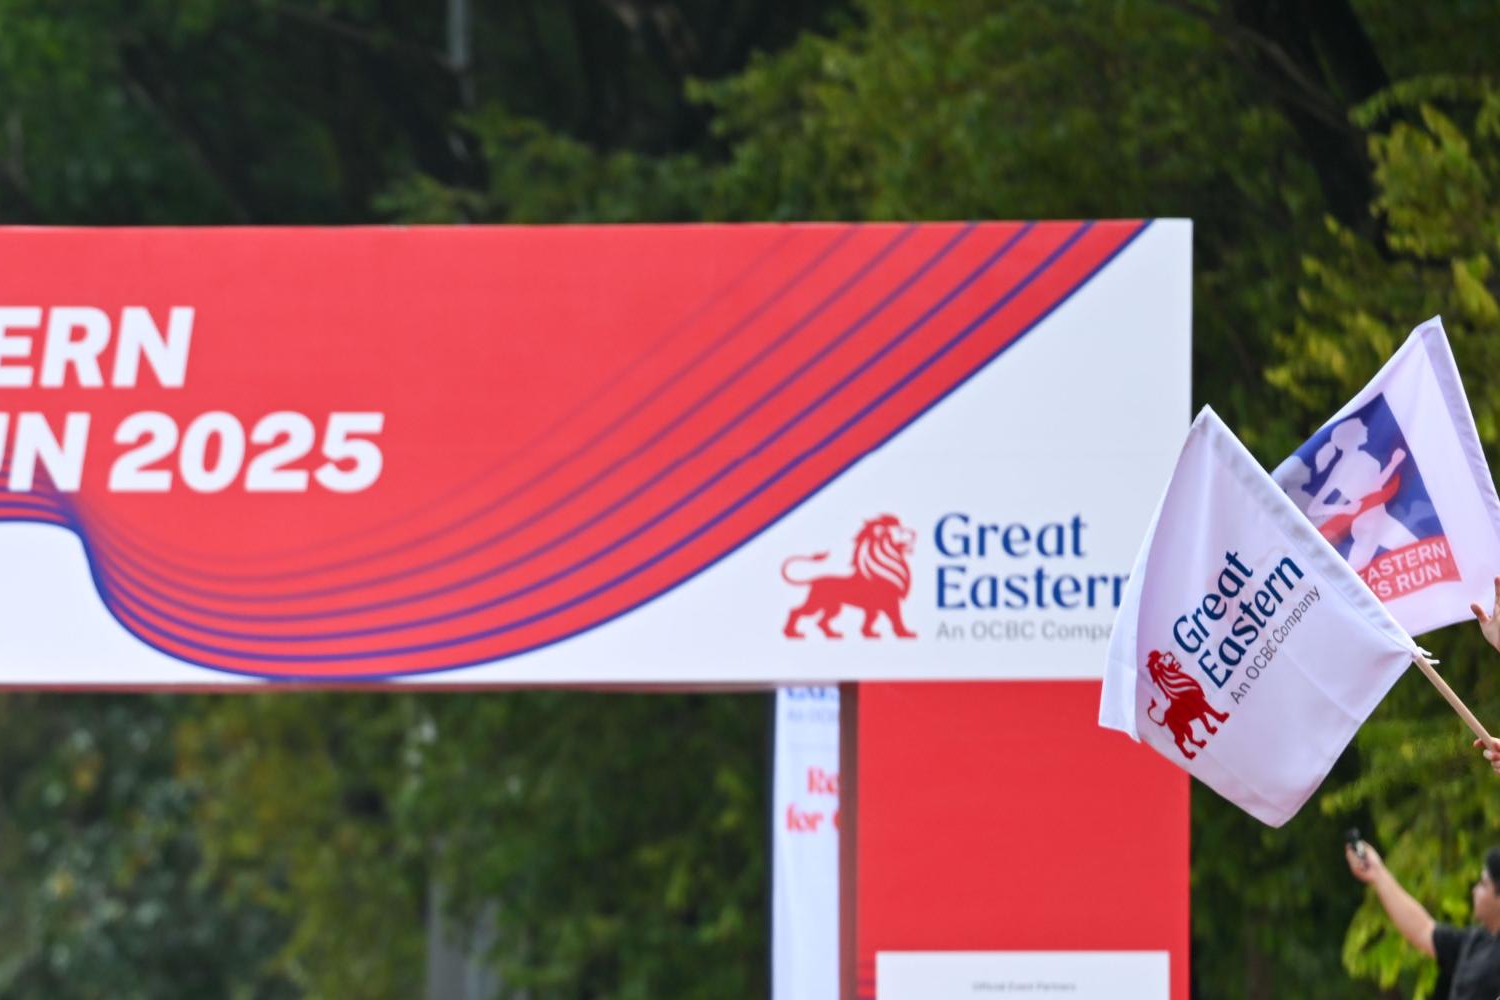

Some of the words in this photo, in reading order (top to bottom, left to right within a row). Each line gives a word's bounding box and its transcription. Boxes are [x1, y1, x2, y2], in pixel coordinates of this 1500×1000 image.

[107, 411, 385, 493] 2025
[934, 512, 1087, 558] Great
[1361, 542, 1448, 584] ASTERN
[1173, 551, 1253, 654] Great
[1395, 563, 1443, 592] RUN
[936, 620, 965, 640] An
[971, 619, 1035, 641] OCBC
[1042, 620, 1114, 646] Compa
[1198, 556, 1304, 689] Eastern
[1230, 681, 1251, 704] An
[1245, 638, 1278, 680] OCBC
[1272, 585, 1321, 644] Company
